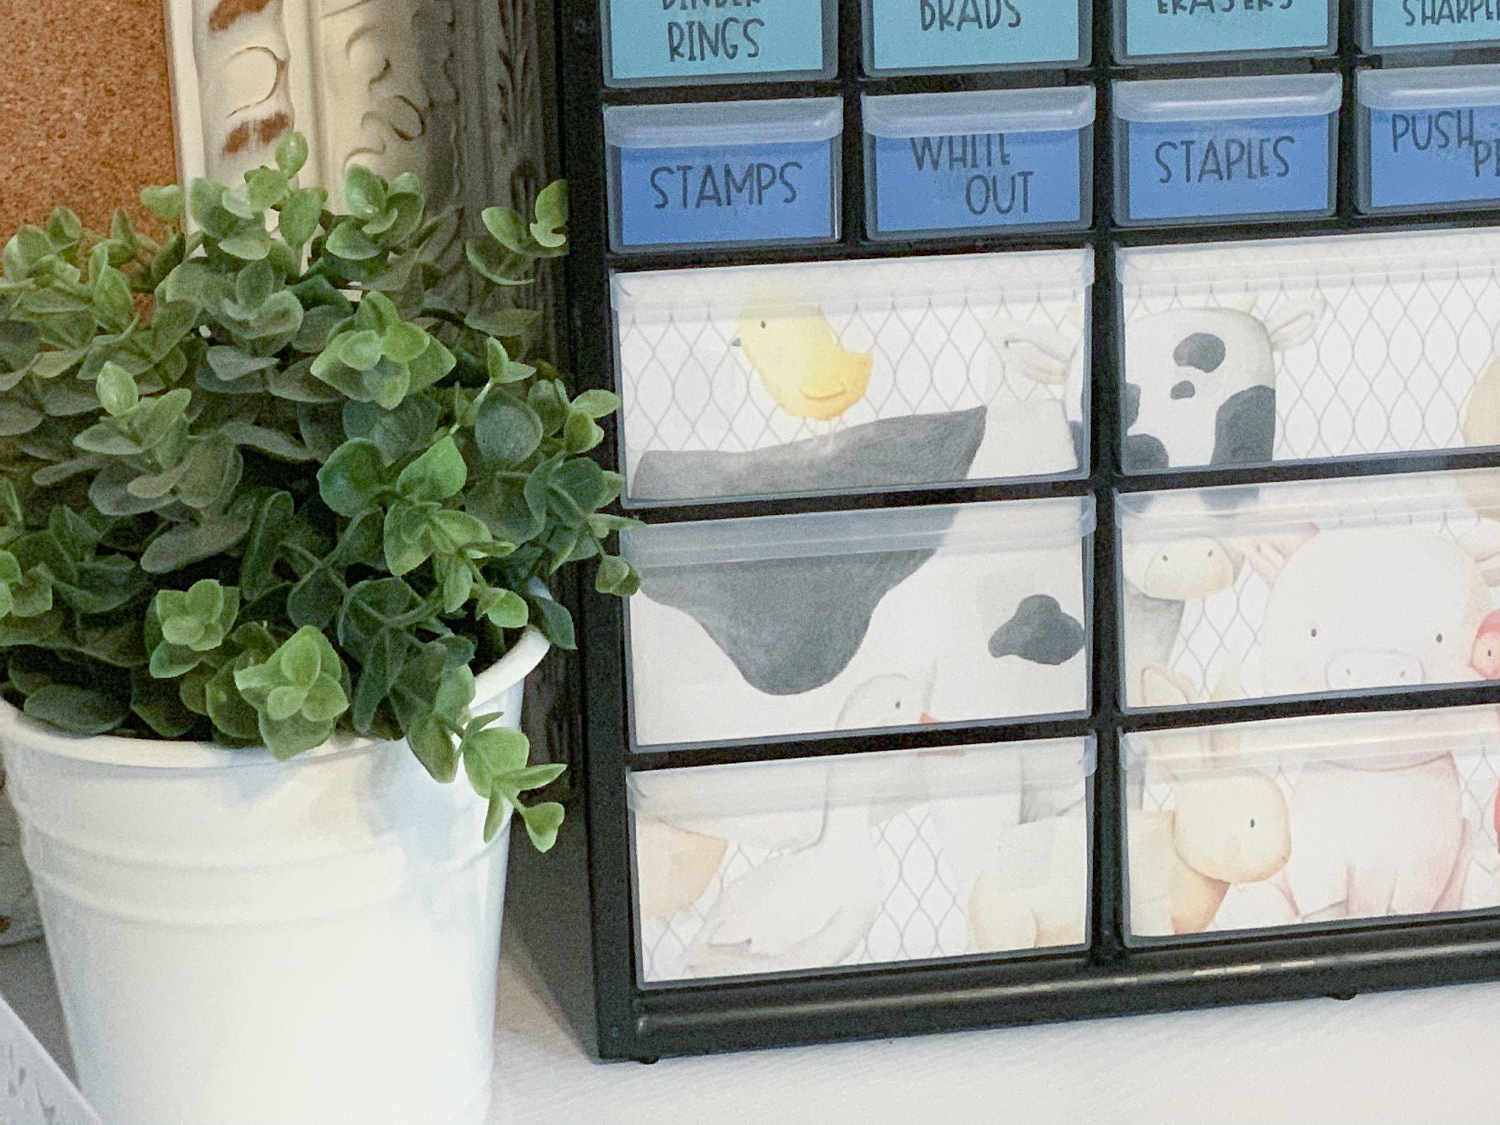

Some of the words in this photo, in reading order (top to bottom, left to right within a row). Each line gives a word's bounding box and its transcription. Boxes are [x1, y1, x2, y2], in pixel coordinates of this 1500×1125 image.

[667, 18, 764, 61] RINGS
[1392, 110, 1475, 153] PUSH
[1155, 136, 1295, 184] STAPLES
[651, 161, 801, 210] STAMPS
[965, 172, 1031, 216] OUT
